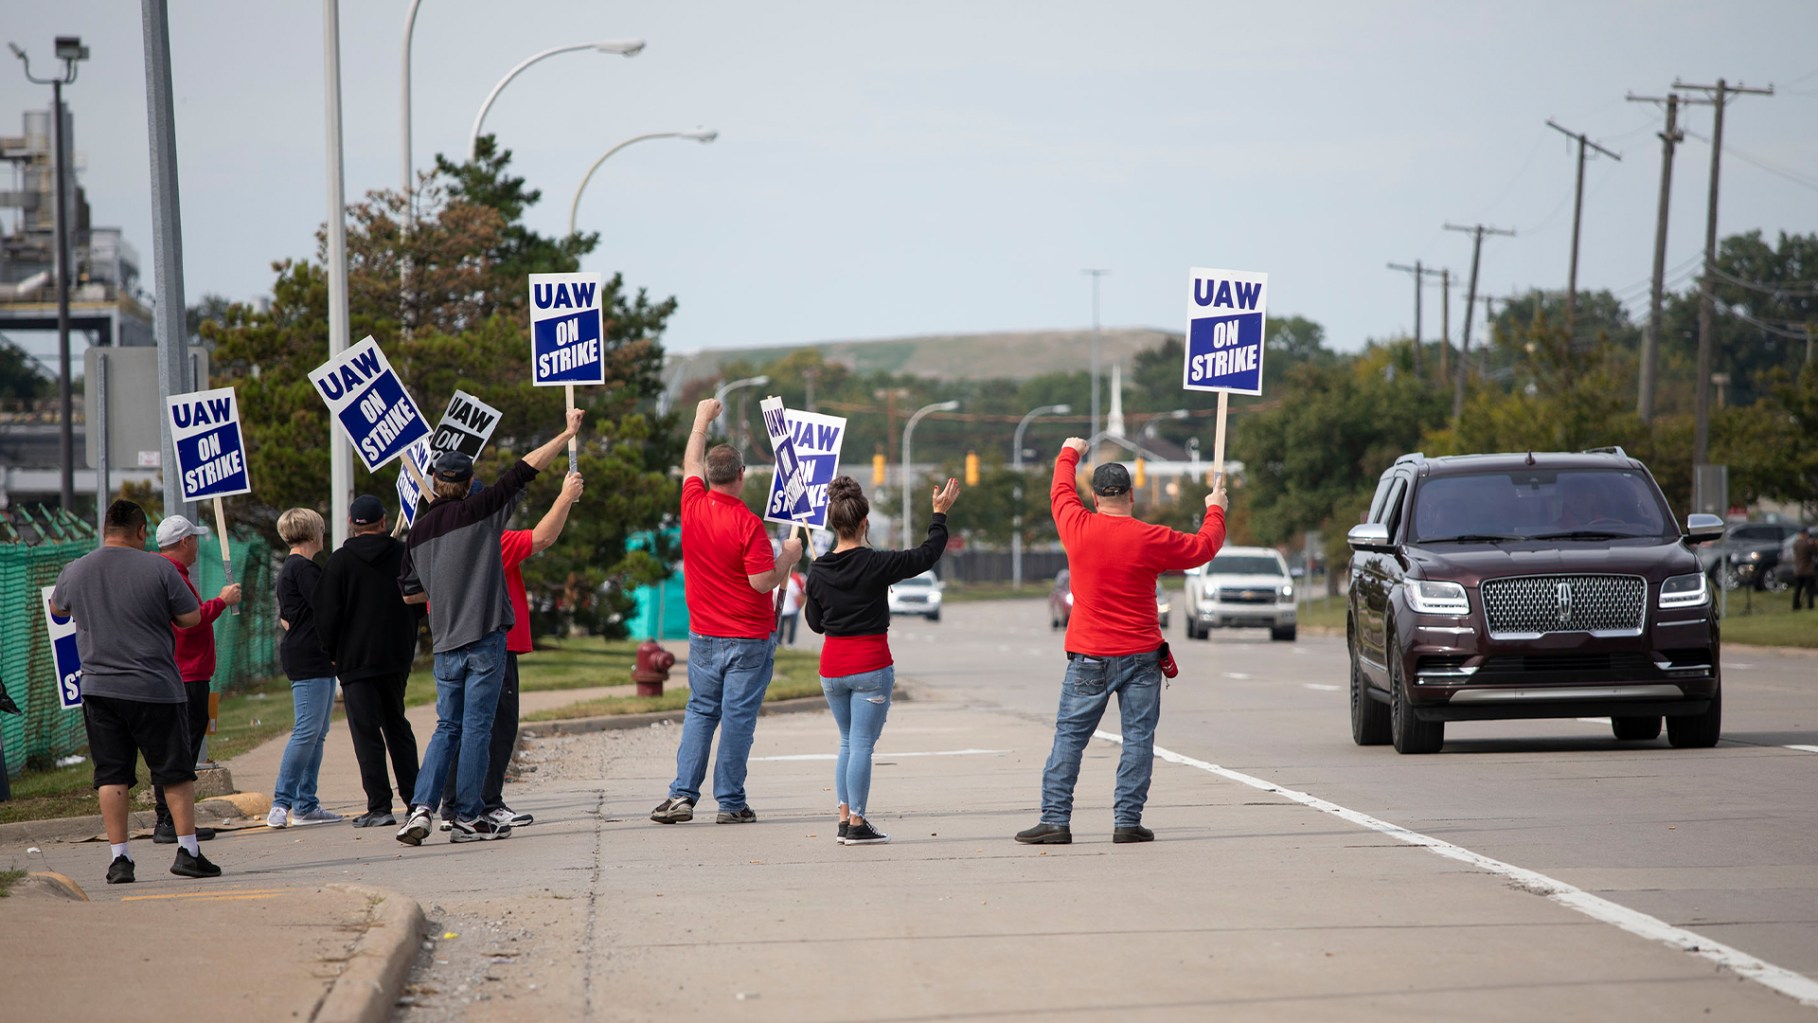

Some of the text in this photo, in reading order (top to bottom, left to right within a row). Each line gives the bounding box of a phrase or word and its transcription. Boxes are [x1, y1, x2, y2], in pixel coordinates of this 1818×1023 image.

[534, 282, 596, 309] UAW
[1194, 278, 1262, 310] UAW
[556, 317, 579, 347] ON
[1213, 319, 1239, 349] ON
[318, 347, 382, 401] UAW
[538, 338, 598, 378] STRIKE
[1191, 344, 1258, 382] STRIKE
[172, 397, 231, 429] UAW
[360, 388, 387, 424] ON
[447, 396, 495, 434] UAW
[361, 396, 416, 462] STRIKE
[764, 408, 788, 438] UAW
[198, 432, 222, 462] ON
[435, 430, 466, 451] ON
[185, 449, 242, 494] STRIKE
